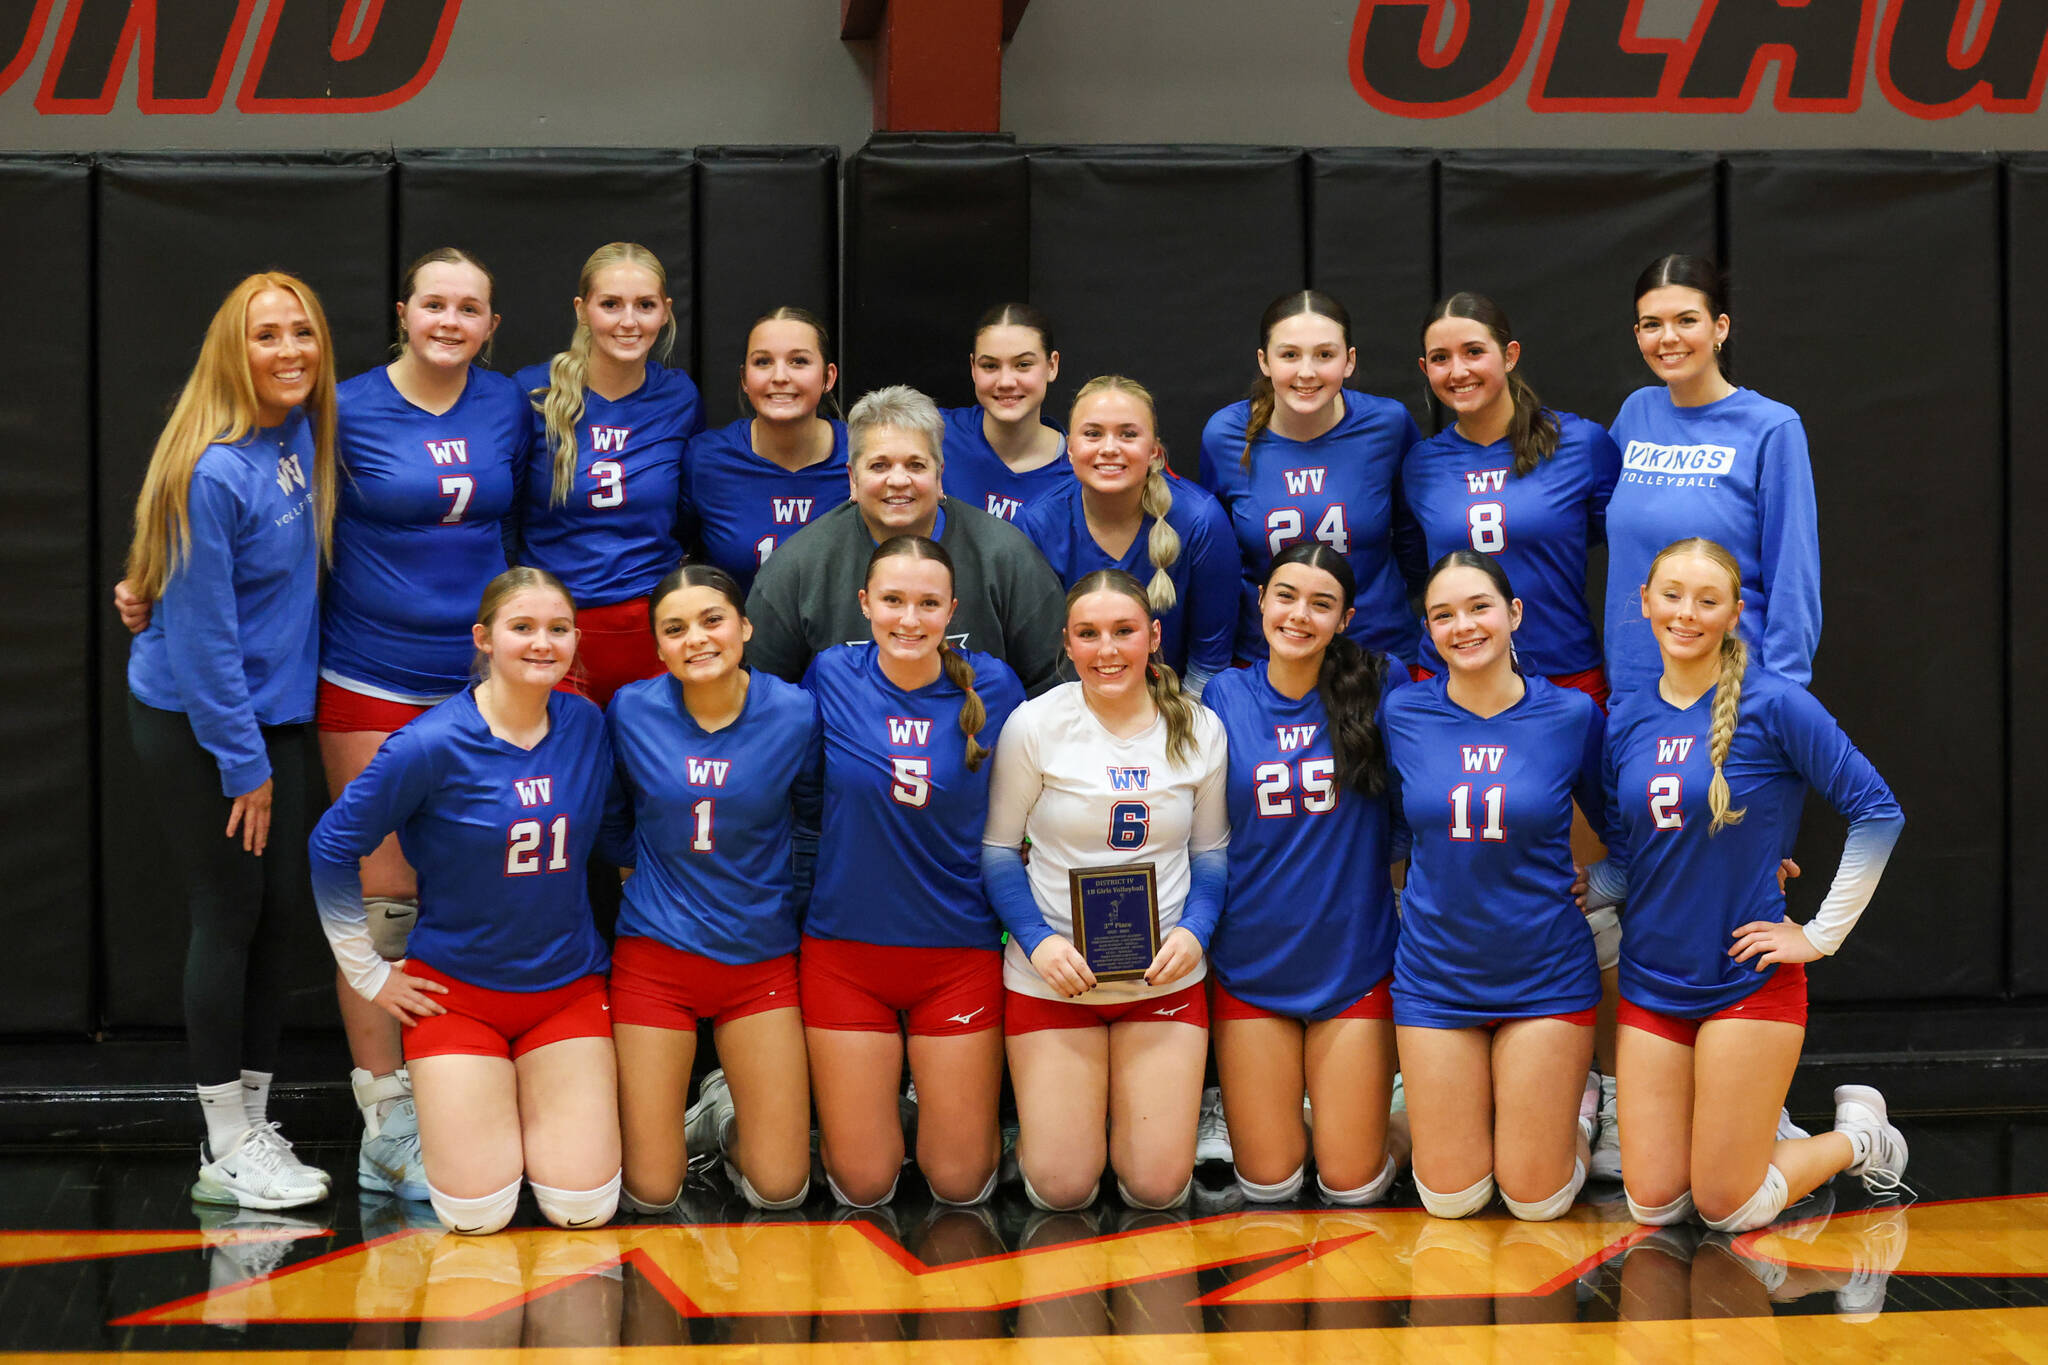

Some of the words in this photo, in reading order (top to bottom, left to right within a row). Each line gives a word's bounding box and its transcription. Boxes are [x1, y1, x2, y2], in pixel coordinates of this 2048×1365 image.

[424, 438, 468, 466] WV
[589, 425, 631, 452] WV
[1628, 445, 1726, 470] VIKINGS
[588, 458, 627, 510] 3
[1282, 466, 1327, 496] WV
[1465, 467, 1510, 494] WV
[438, 474, 476, 526] 7
[771, 497, 814, 524] WV
[1265, 503, 1350, 557] 24
[1467, 501, 1507, 554] 8
[886, 716, 933, 747] WV
[1275, 723, 1319, 752] WV
[1461, 745, 1507, 774] WV
[1656, 735, 1696, 765] WV
[686, 756, 732, 788] WV
[888, 755, 932, 810] 5
[1107, 766, 1150, 791] WV
[1253, 756, 1339, 818] 25
[513, 775, 552, 808] WV
[1647, 773, 1684, 831] 2
[691, 797, 715, 853] 1
[1107, 800, 1150, 851] 6
[1448, 783, 1507, 842] 11
[504, 814, 569, 877] 21
[1095, 878, 1126, 887] DISTRICT
[1096, 887, 1112, 895] Girls
[1113, 886, 1145, 894] Volleyball
